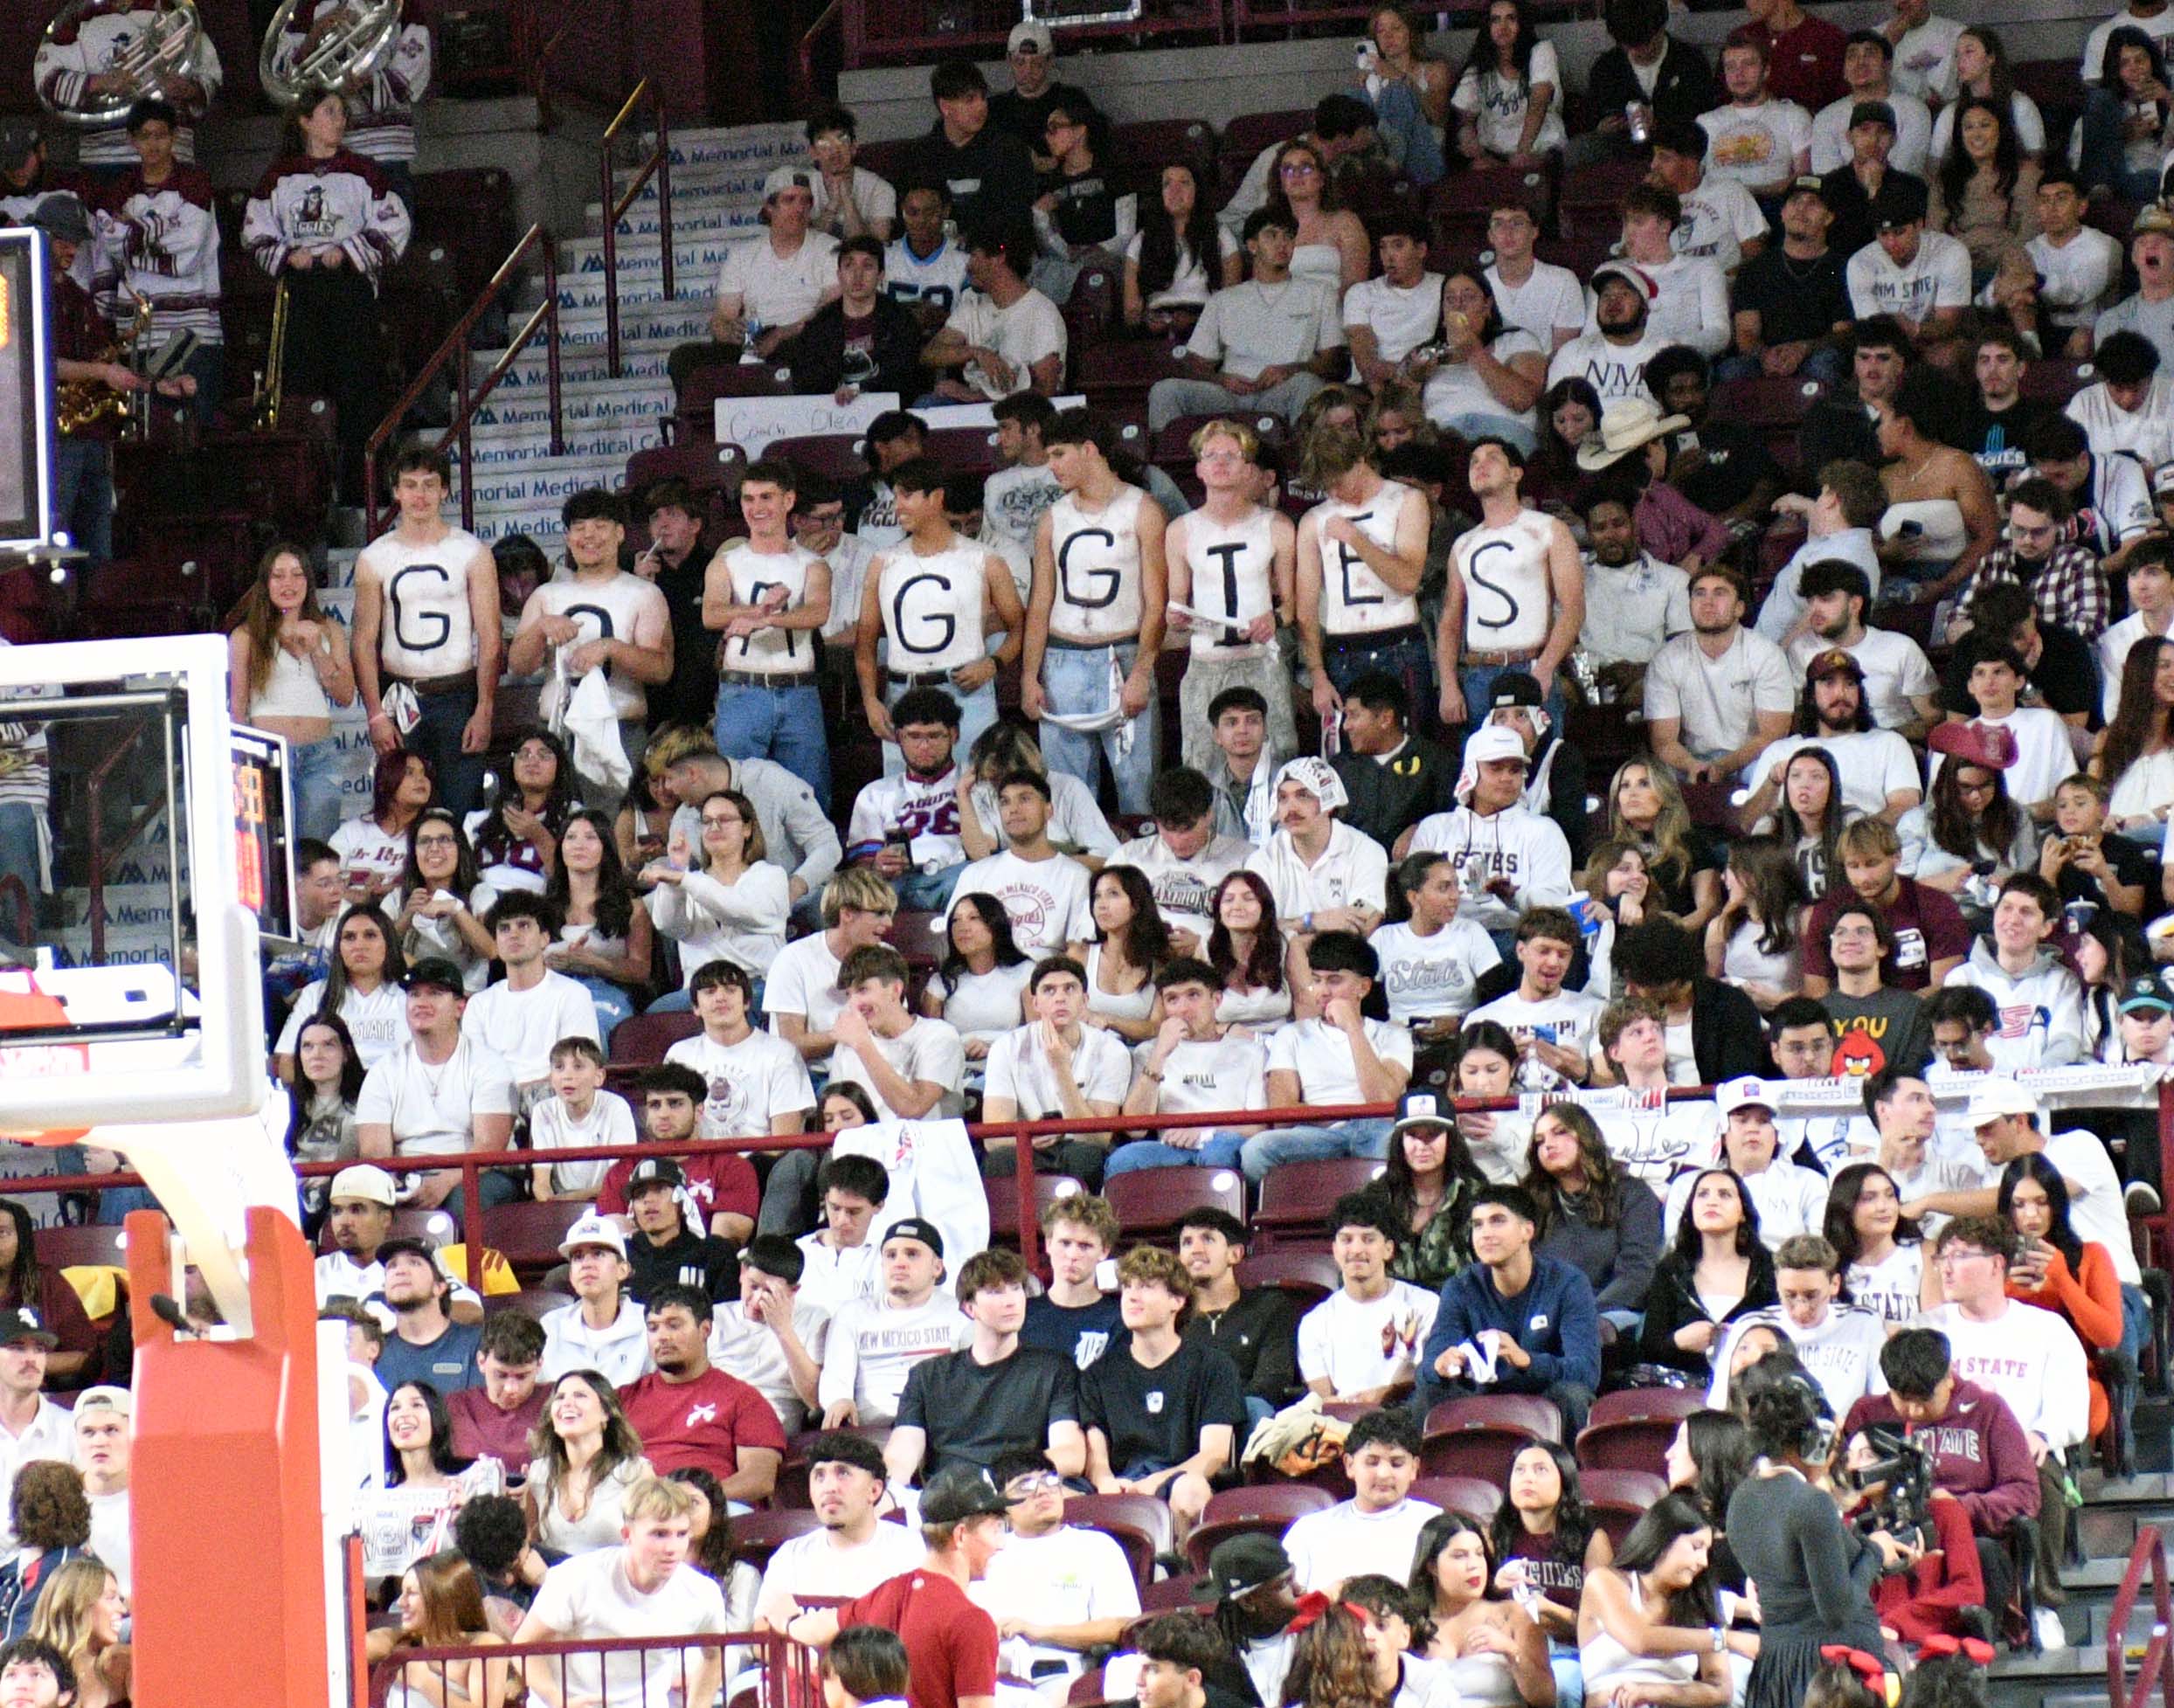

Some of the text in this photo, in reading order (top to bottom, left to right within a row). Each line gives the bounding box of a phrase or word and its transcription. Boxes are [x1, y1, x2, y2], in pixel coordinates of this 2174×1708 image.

[597, 398, 668, 418] Medical
[389, 564, 451, 652] G
[892, 573, 957, 654] G
[1057, 527, 1122, 609] G
[1338, 510, 1385, 607] E
[1469, 539, 1520, 629] S
[1387, 958, 1466, 994] State
[1833, 1016, 1888, 1040] YOU
[882, 1327, 921, 1348] MEXICO
[924, 1324, 951, 1345] STATE
[1967, 1357, 2028, 1379] STATE
